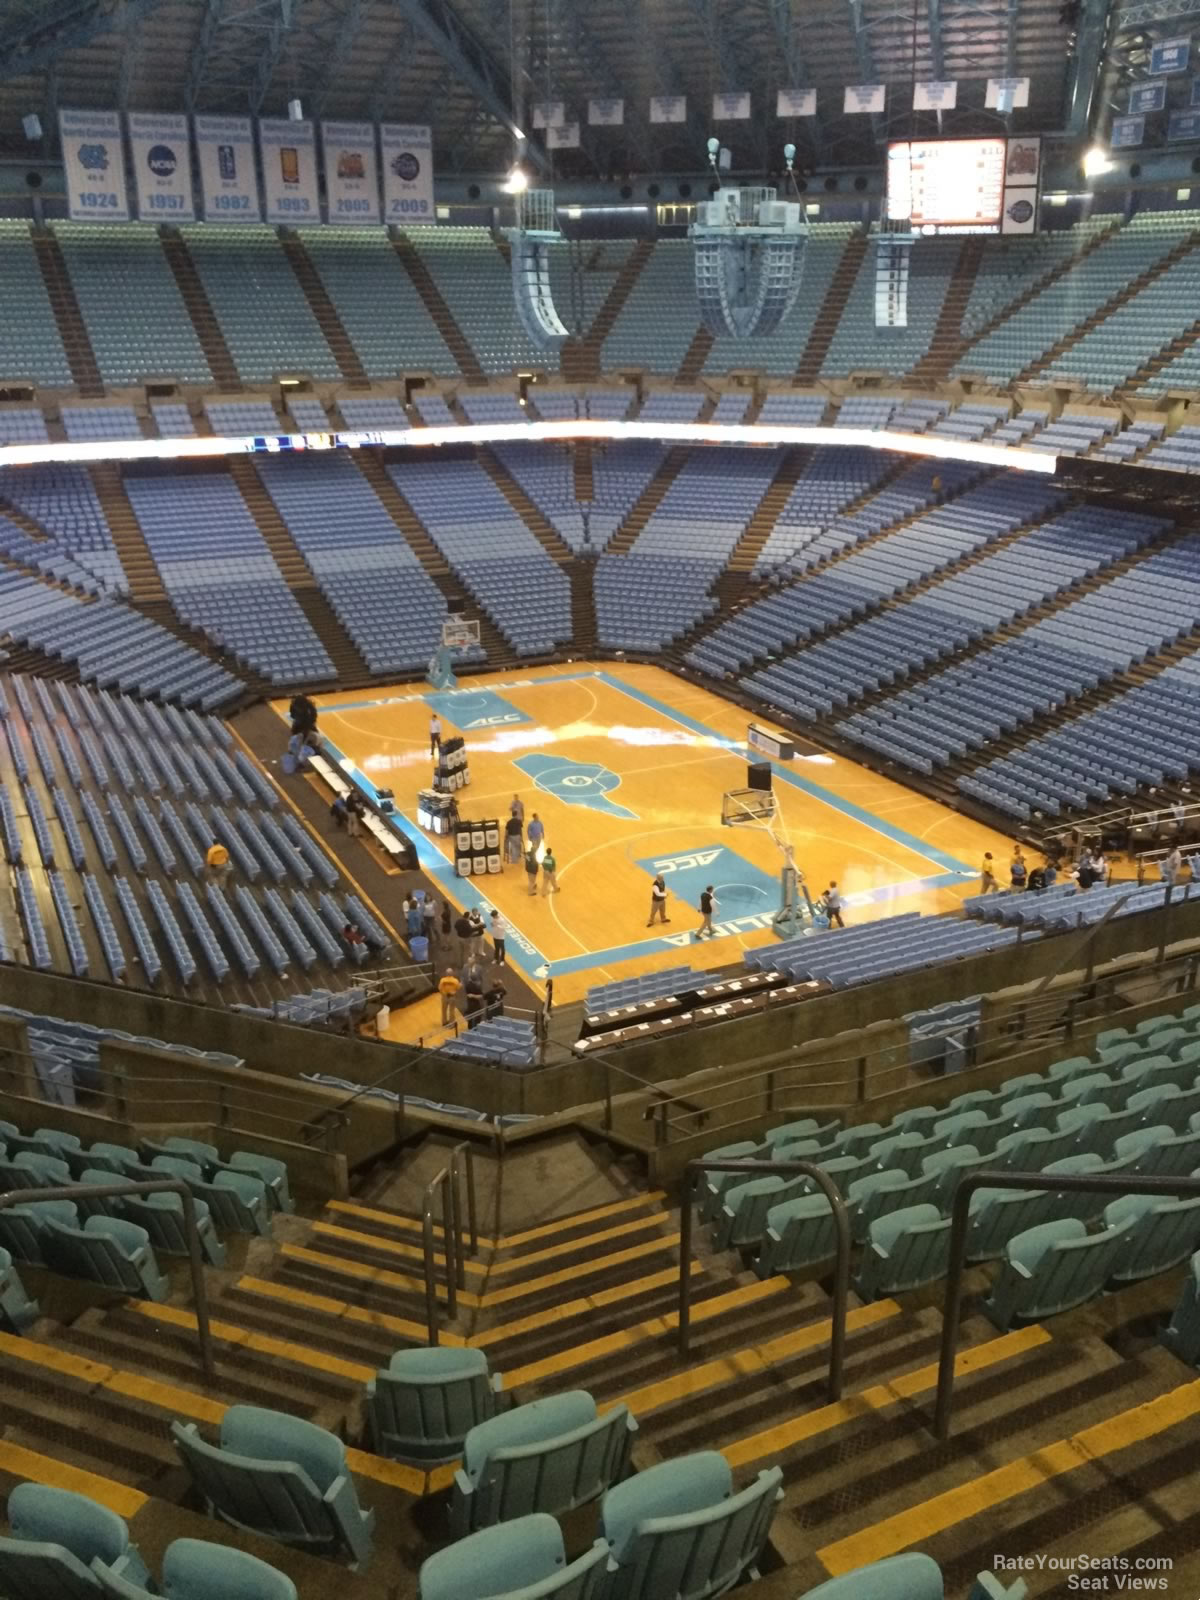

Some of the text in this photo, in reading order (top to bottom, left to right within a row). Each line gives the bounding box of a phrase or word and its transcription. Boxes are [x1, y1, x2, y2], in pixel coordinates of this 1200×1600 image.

[79, 192, 118, 208] 1924
[148, 194, 184, 209] 1957
[213, 195, 249, 209] 1982
[391, 199, 428, 213] 2009
[463, 713, 520, 728] ACC
[652, 848, 724, 874] ACC
